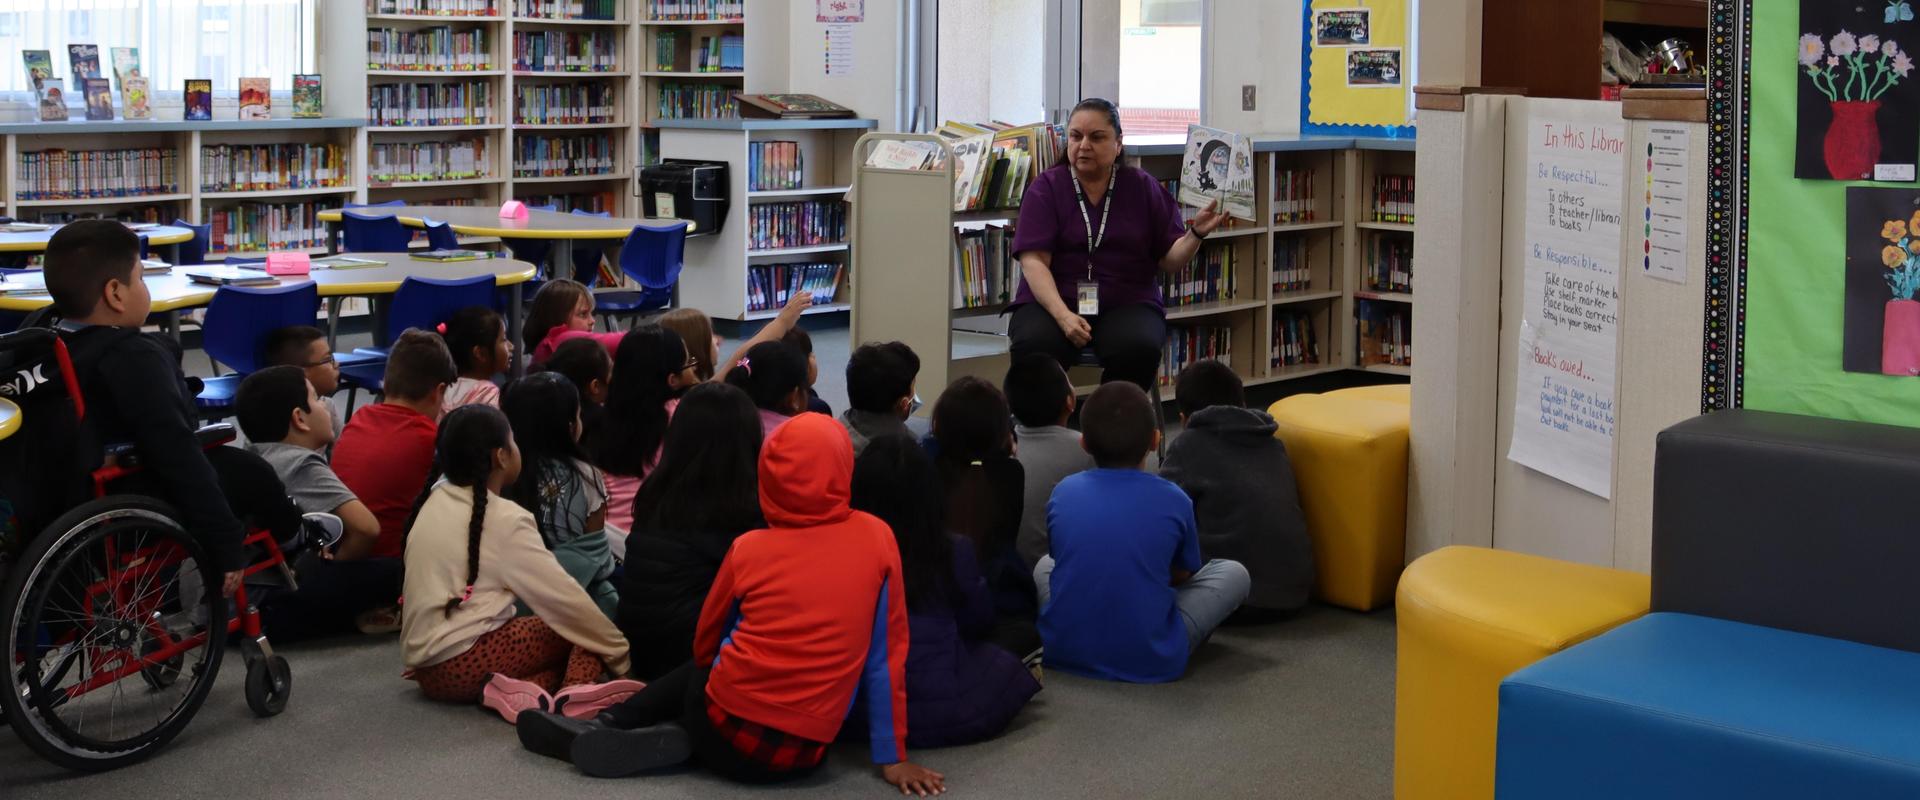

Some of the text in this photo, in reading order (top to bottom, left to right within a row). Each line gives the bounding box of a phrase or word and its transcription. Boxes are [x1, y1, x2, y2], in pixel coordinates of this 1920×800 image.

[1544, 124, 1558, 148] In
[1562, 124, 1585, 150] this
[1538, 162, 1548, 178] Be
[1548, 188, 1585, 207] To others
[1548, 203, 1555, 214] To
[1549, 214, 1582, 232] To books
[1534, 243, 1541, 258] Be
[1544, 272, 1560, 286] Take
[1562, 278, 1583, 292] care
[1584, 281, 1594, 294] of
[1596, 285, 1610, 299] the
[1544, 286, 1555, 297] Use
[1543, 296, 1561, 311] Place
[1563, 301, 1583, 316] books
[1543, 308, 1558, 326] Stay
[1559, 314, 1566, 324] in
[1567, 318, 1581, 331] your
[1534, 346, 1557, 369] Books
